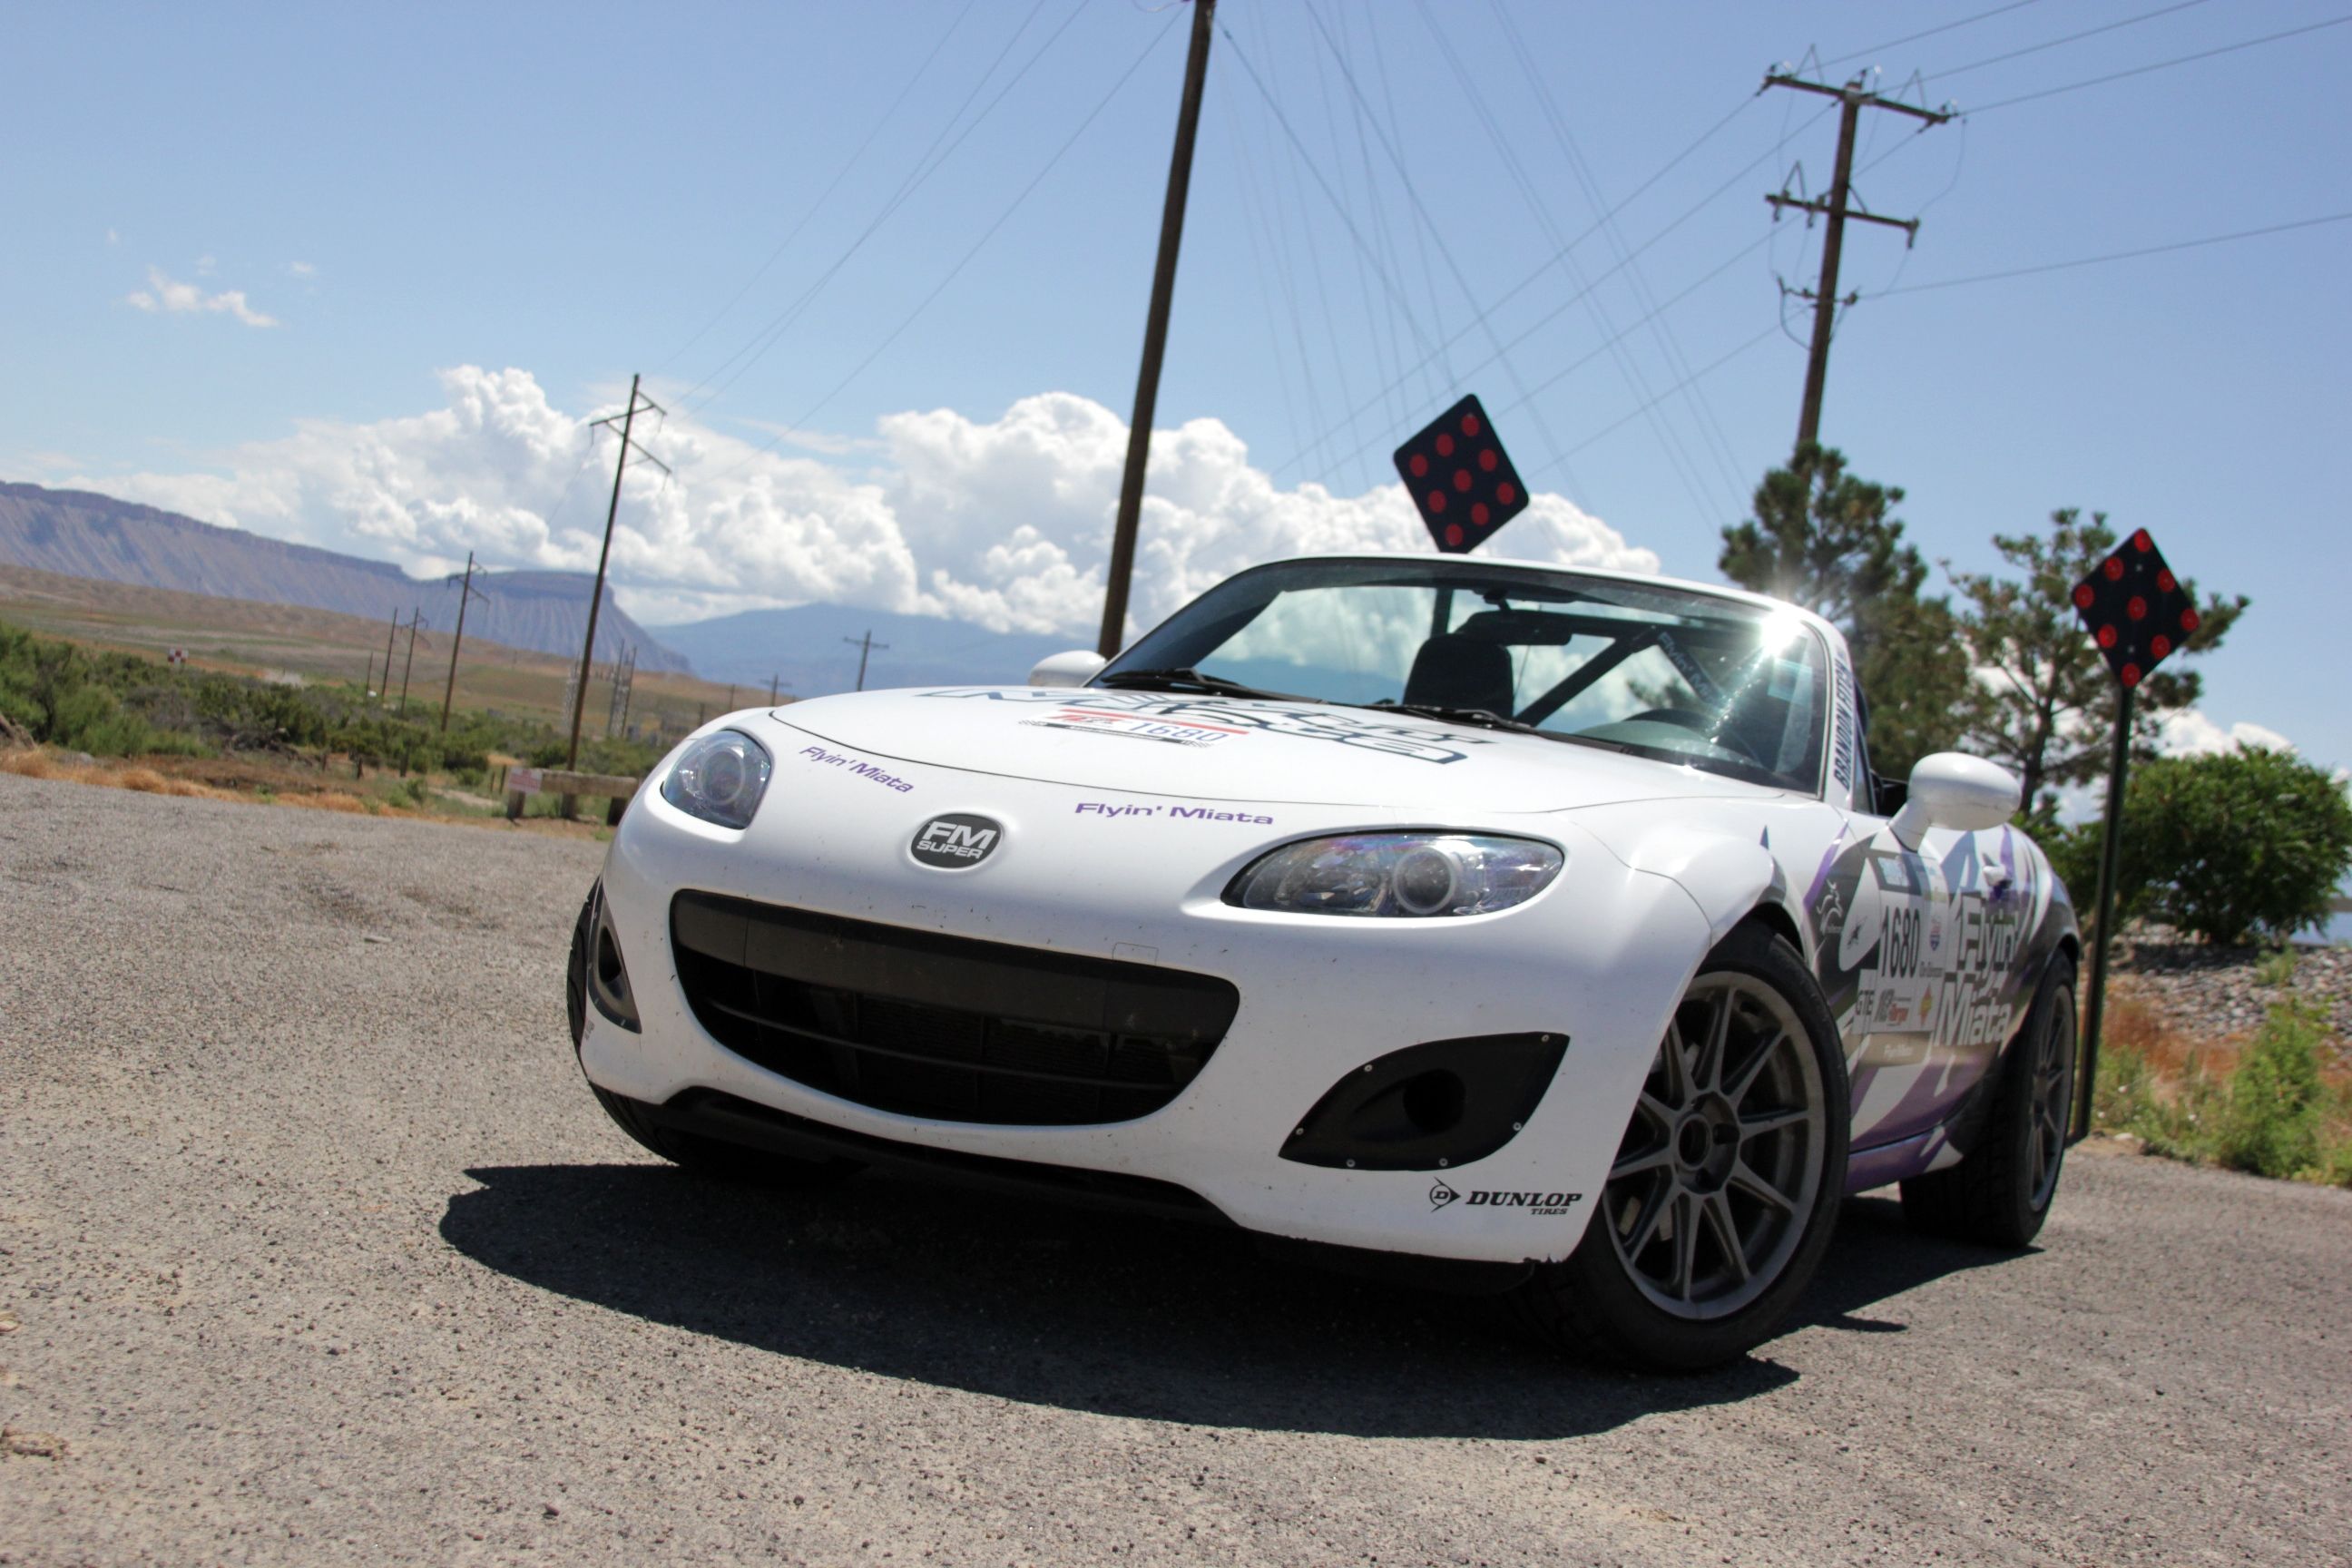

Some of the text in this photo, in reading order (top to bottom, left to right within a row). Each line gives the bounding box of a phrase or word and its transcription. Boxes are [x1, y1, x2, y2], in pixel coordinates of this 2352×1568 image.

[1127, 722, 1230, 742] 1680
[1833, 703, 1853, 791] BRANDON
[799, 746, 914, 793] Flyin' Miata
[1074, 802, 1274, 825] Flyin' Miata
[921, 819, 997, 849] FM
[916, 839, 984, 860] SUPER
[1881, 905, 1921, 979] 1680
[1934, 981, 2013, 1046] Miata
[1465, 1191, 1583, 1207] DUNLOP
